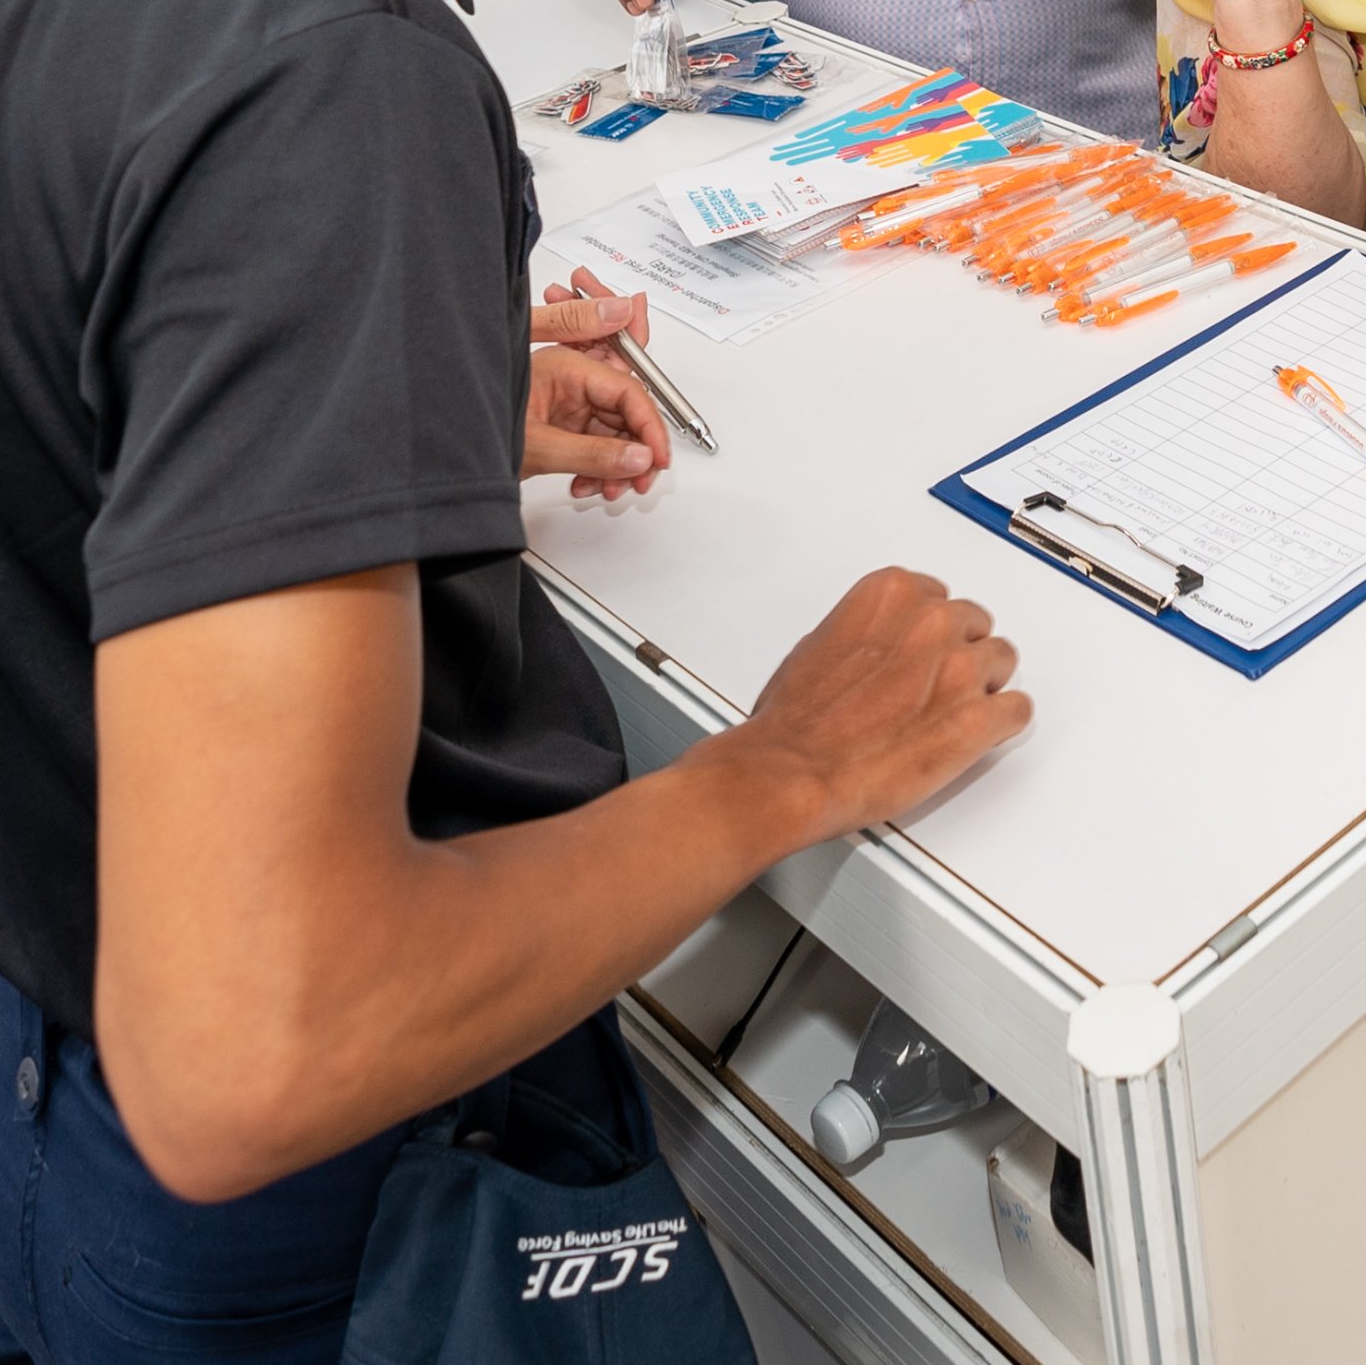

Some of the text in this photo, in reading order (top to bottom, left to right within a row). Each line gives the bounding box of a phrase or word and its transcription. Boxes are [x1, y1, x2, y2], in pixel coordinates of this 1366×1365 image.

[686, 190, 724, 234] COMMUNITY
[700, 186, 739, 229] EMERGENCY
[719, 188, 755, 226] RESPONSE
[746, 201, 769, 222] TEAM
[649, 258, 686, 279] (DARE)
[1189, 593, 1254, 629] Course Waiting
[517, 1216, 688, 1252] The Life Saving Force
[521, 1240, 679, 1300] SCDF
